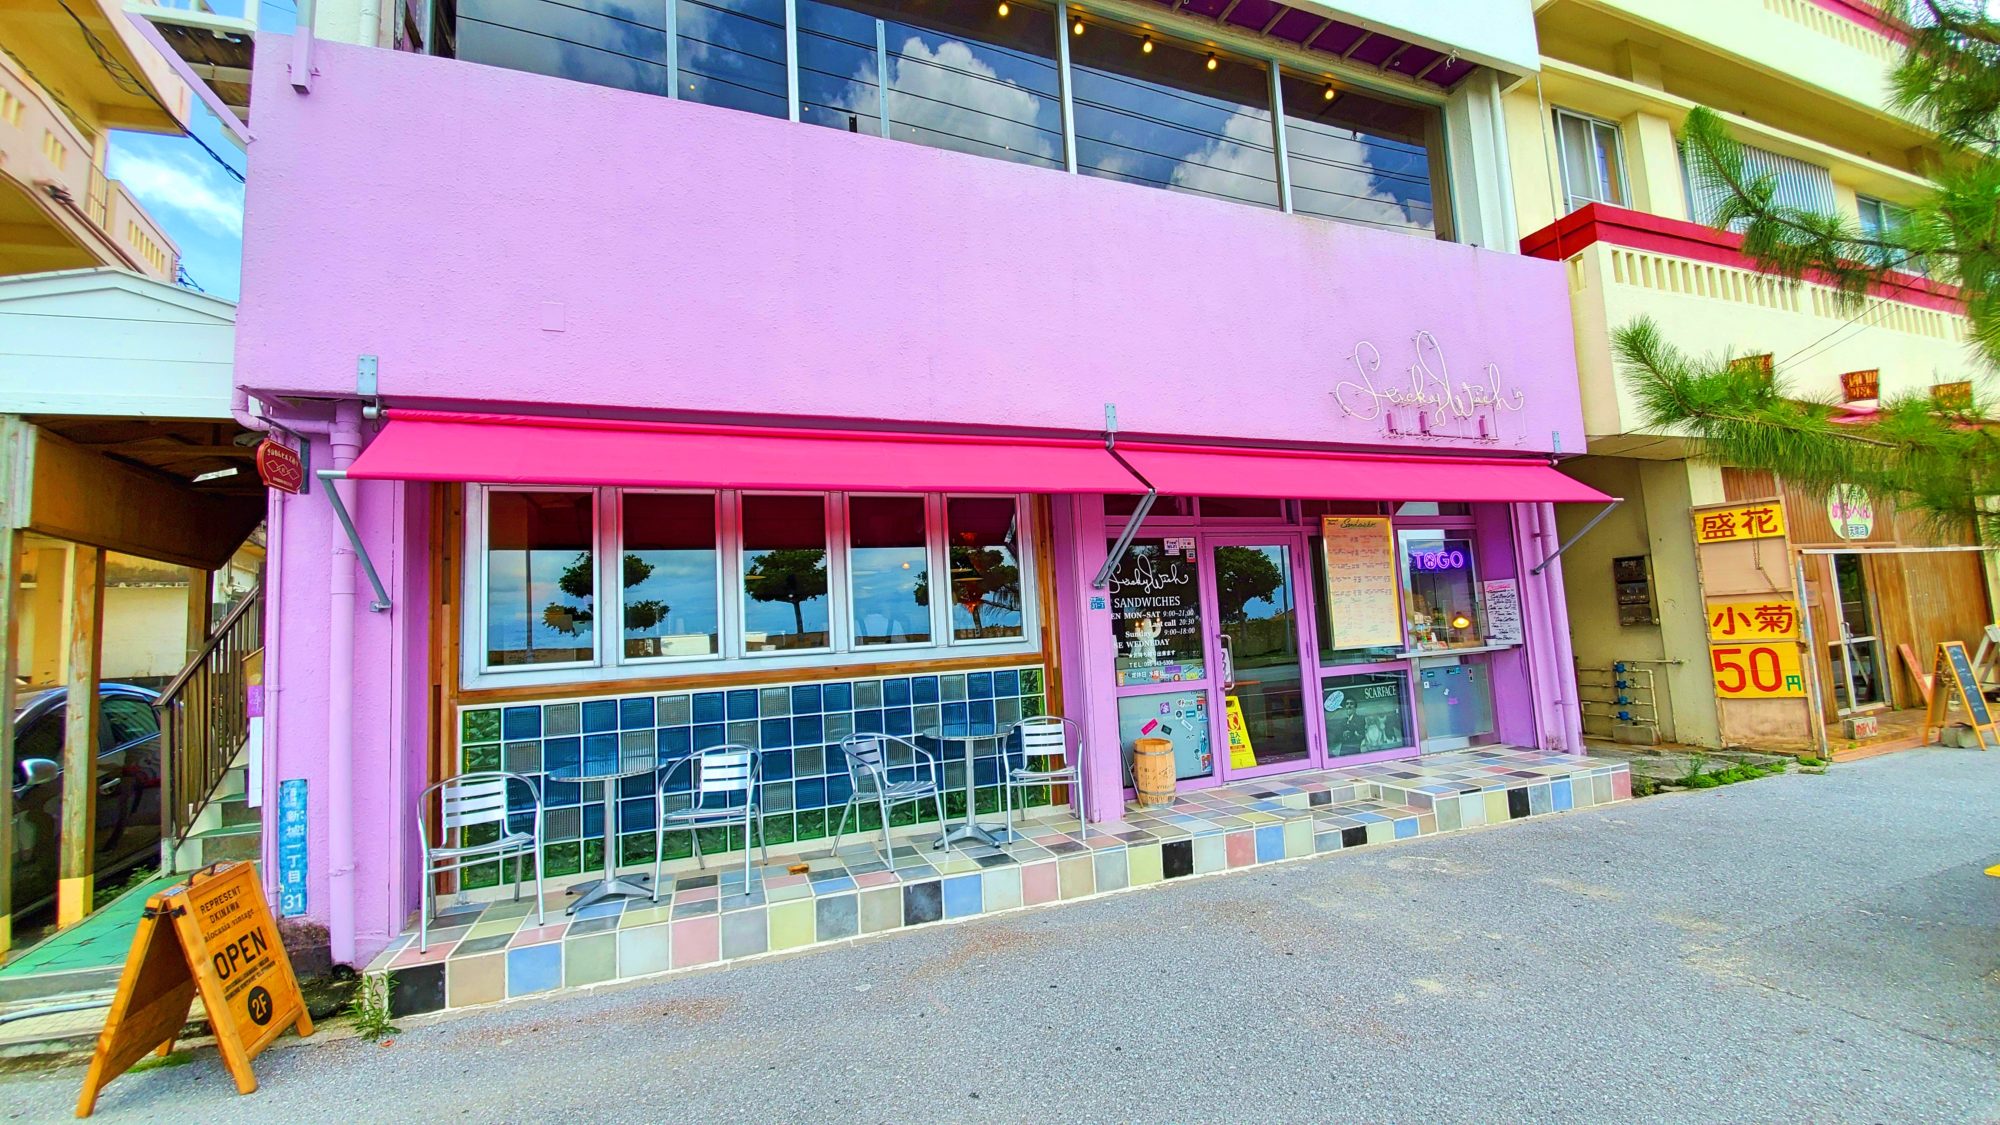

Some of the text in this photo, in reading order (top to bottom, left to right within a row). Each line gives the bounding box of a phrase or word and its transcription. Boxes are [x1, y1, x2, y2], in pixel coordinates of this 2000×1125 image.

[1702, 508, 1778, 539] 盛花
[1114, 596, 1181, 608] SANDWICHES
[1713, 605, 1793, 635] 小菊
[1125, 630, 1151, 638] Sunday
[1713, 647, 1802, 692] 50円
[1365, 685, 1397, 699] SCARFACE
[200, 885, 241, 915] REPRESENT
[209, 902, 241, 924] OKINAWA
[284, 893, 304, 909] 31
[213, 927, 268, 981] OPEN
[251, 993, 267, 1020] 2F
